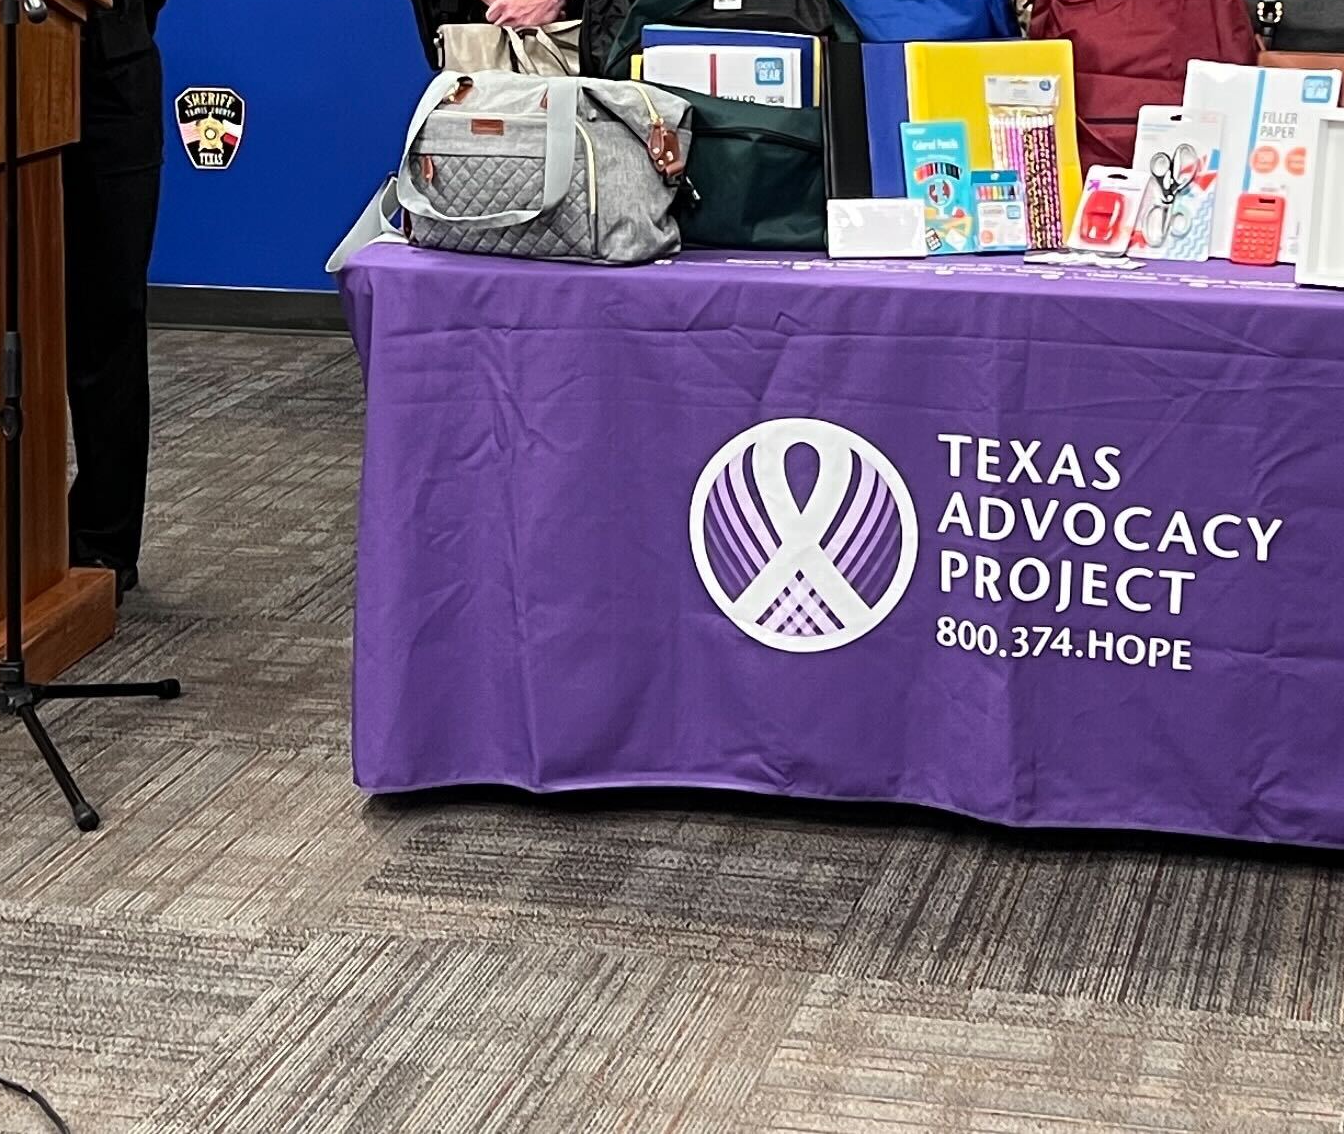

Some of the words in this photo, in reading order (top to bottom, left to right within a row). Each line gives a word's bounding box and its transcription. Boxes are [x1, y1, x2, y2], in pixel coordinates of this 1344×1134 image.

[184, 92, 235, 108] SHERIFF
[1260, 126, 1295, 139] PAPER
[1262, 112, 1298, 125] FILLER
[199, 152, 223, 165] TEXAS
[938, 433, 1121, 491] TEXAS
[938, 492, 1283, 561] ADVOCACY
[940, 550, 1196, 614] PROJECT
[936, 616, 1192, 670] 800.374.HOPE
